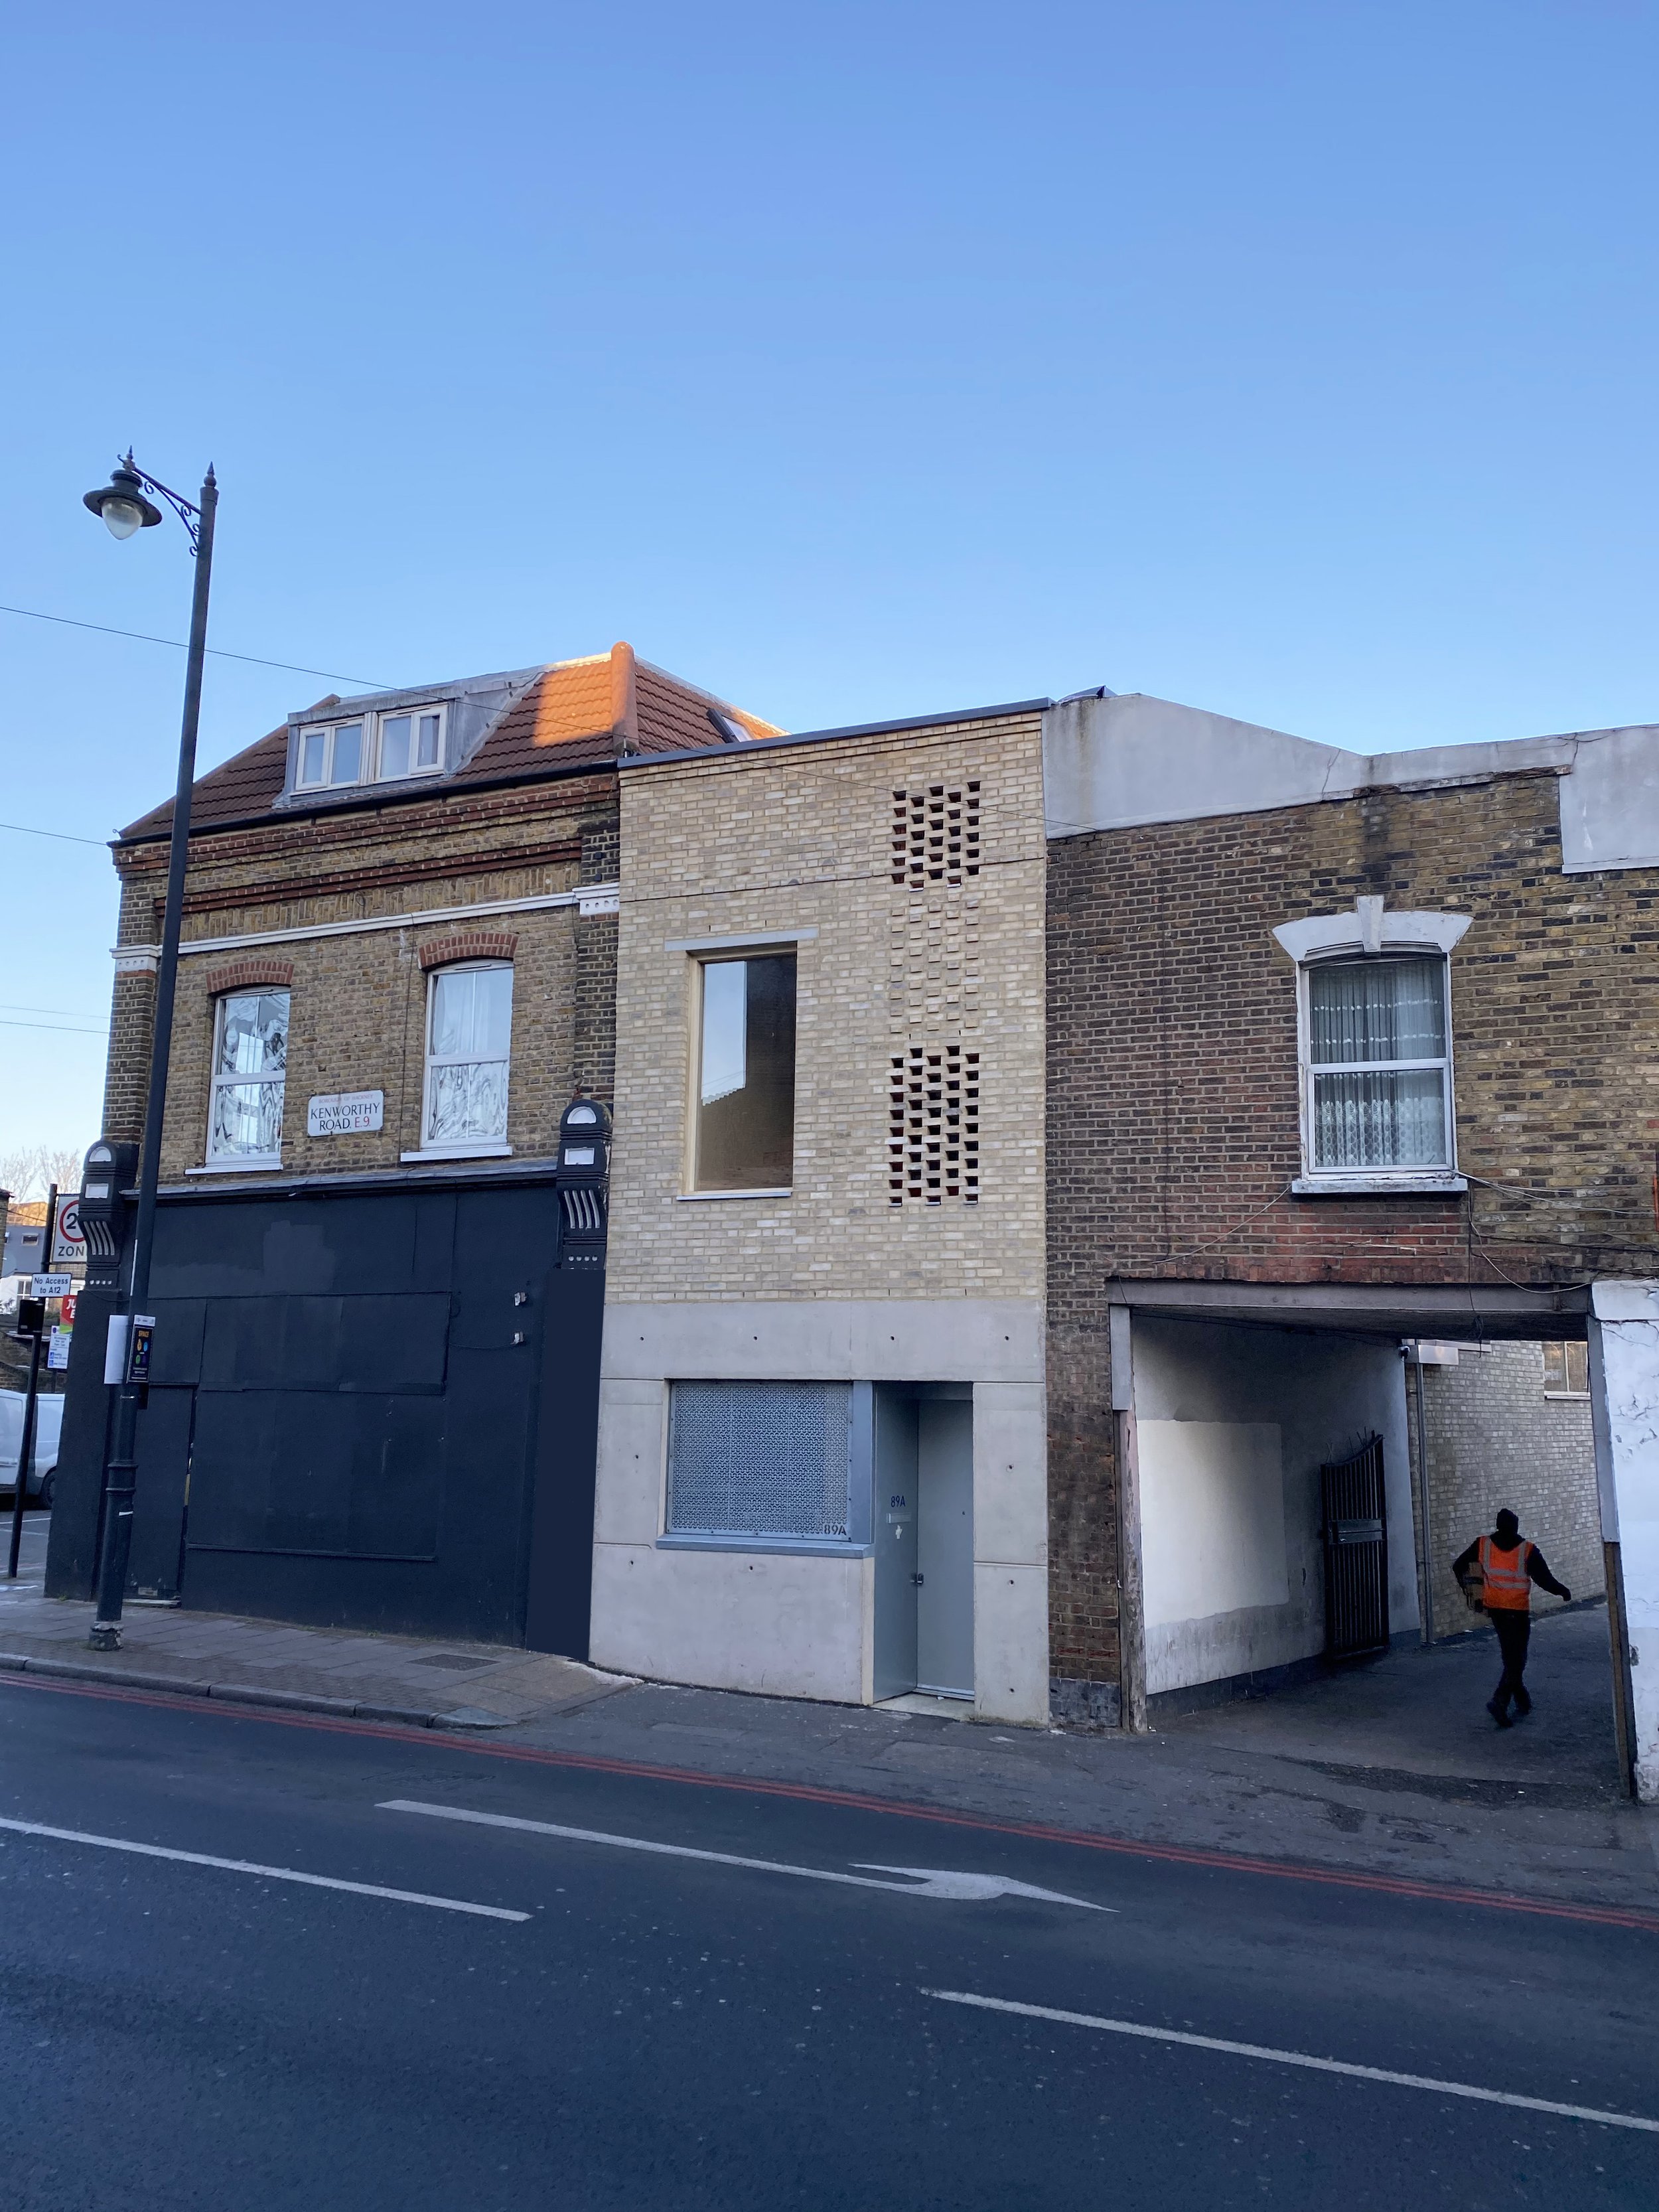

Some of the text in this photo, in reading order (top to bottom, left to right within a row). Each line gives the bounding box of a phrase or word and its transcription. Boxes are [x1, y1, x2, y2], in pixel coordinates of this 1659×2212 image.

[311, 1102, 380, 1120] KENWORTHY
[66, 1213, 78, 1229] 2
[58, 1246, 84, 1256] ZON
[891, 1495, 906, 1508] 89A
[824, 1524, 847, 1536] 89A
